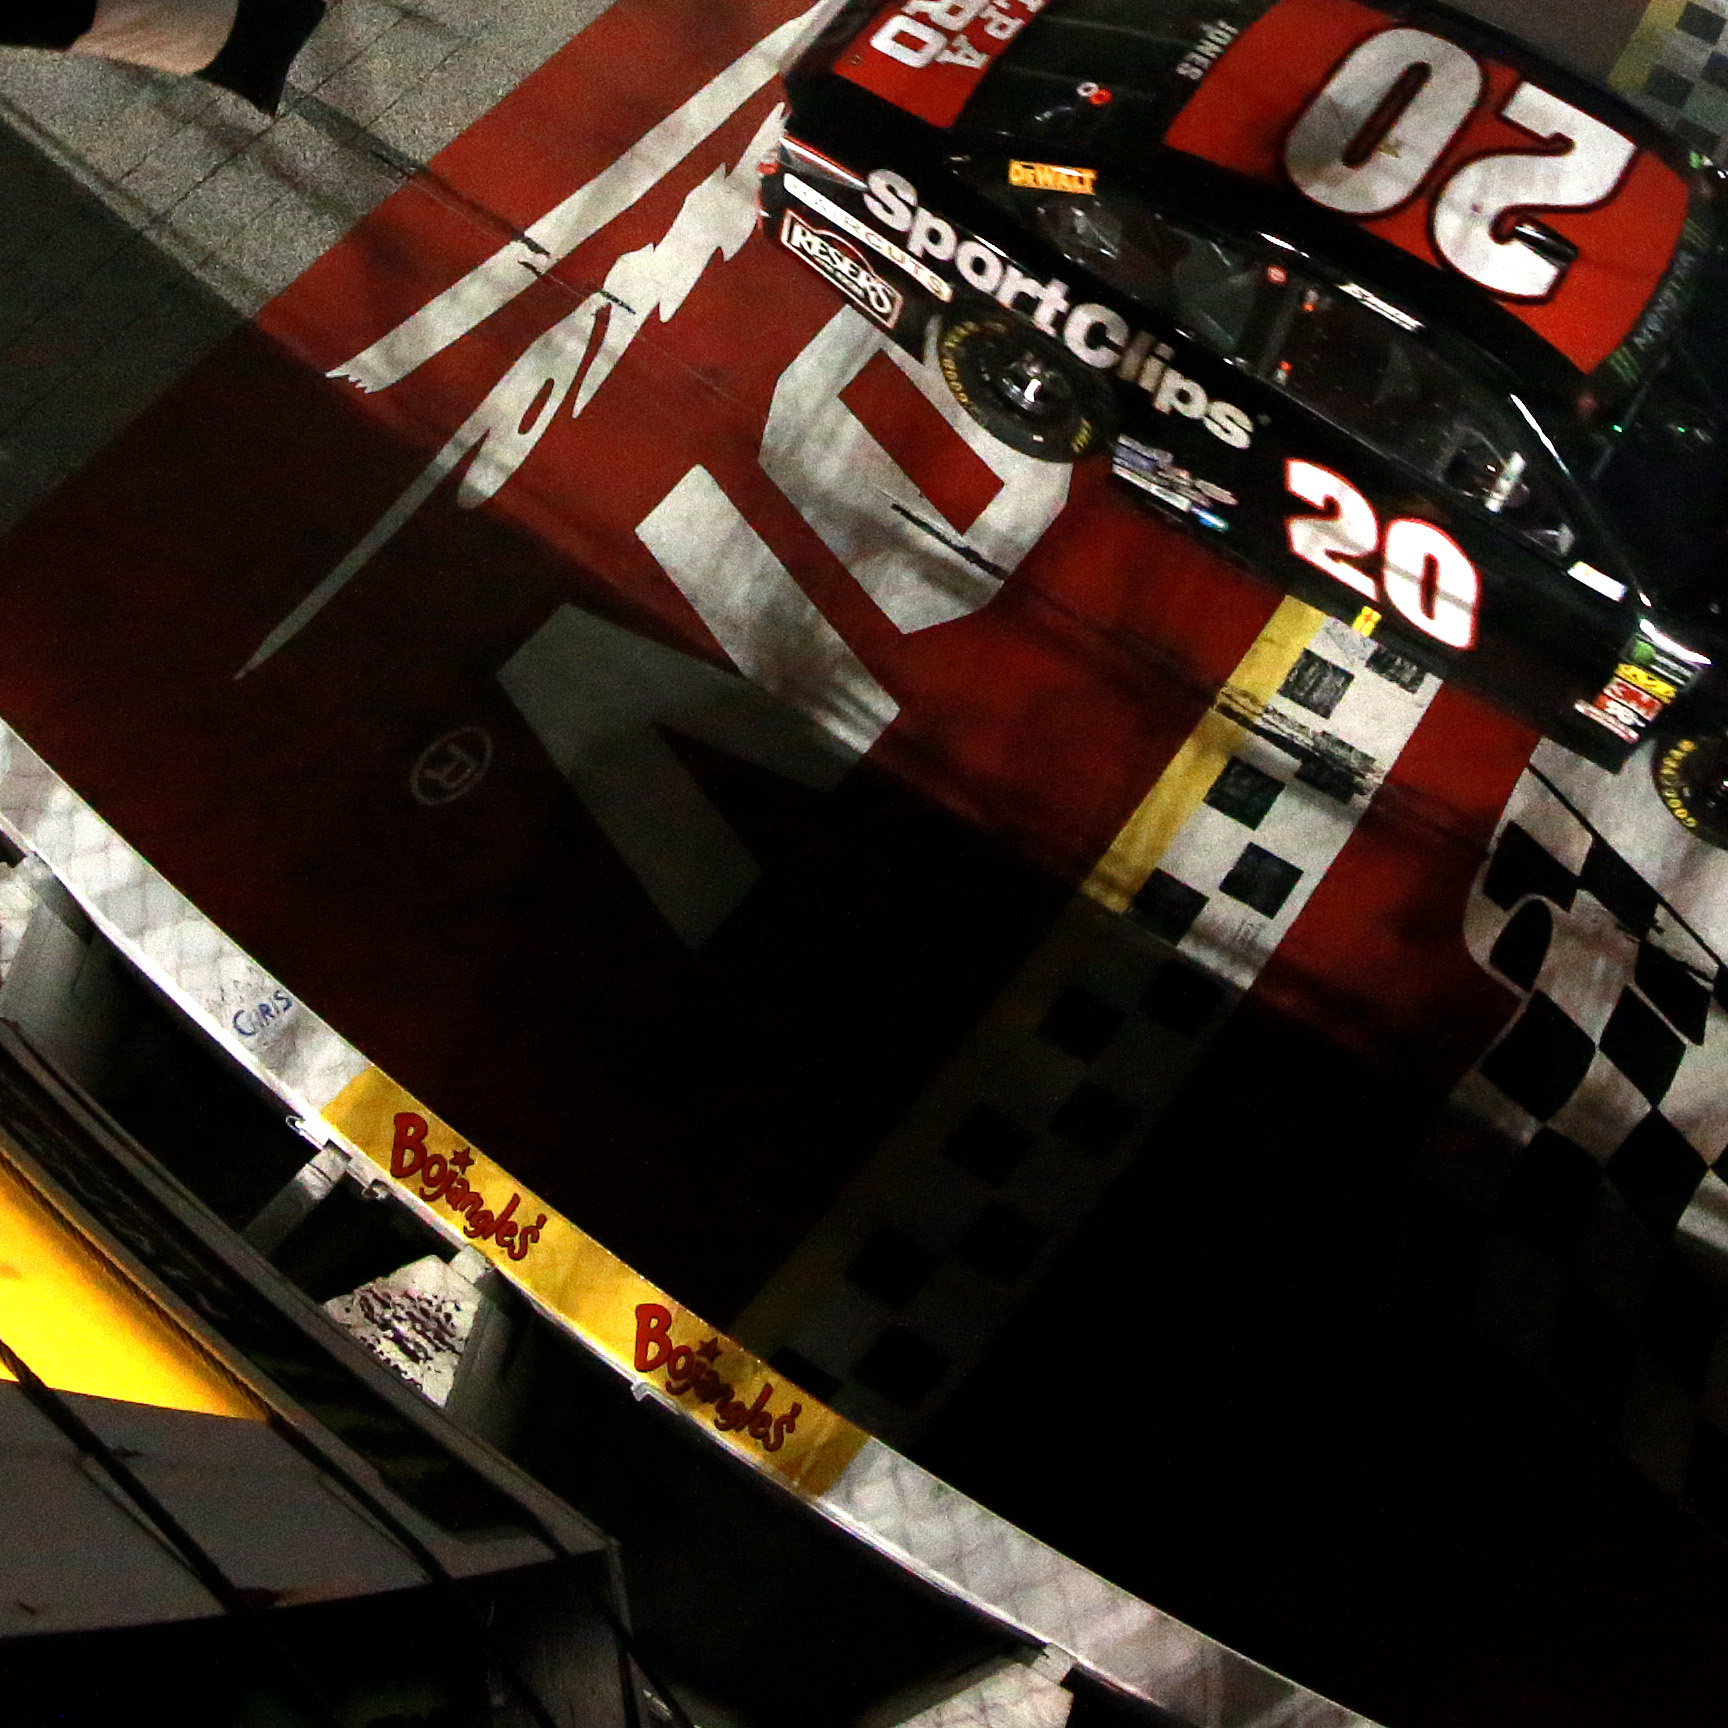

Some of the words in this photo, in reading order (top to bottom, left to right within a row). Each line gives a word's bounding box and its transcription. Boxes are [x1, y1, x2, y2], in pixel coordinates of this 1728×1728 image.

[934, 34, 990, 70] A
[1175, 19, 1239, 81] JONES
[1285, 28, 1637, 299] 20
[863, 168, 1255, 450] SportClips
[1283, 456, 1481, 650] 20
